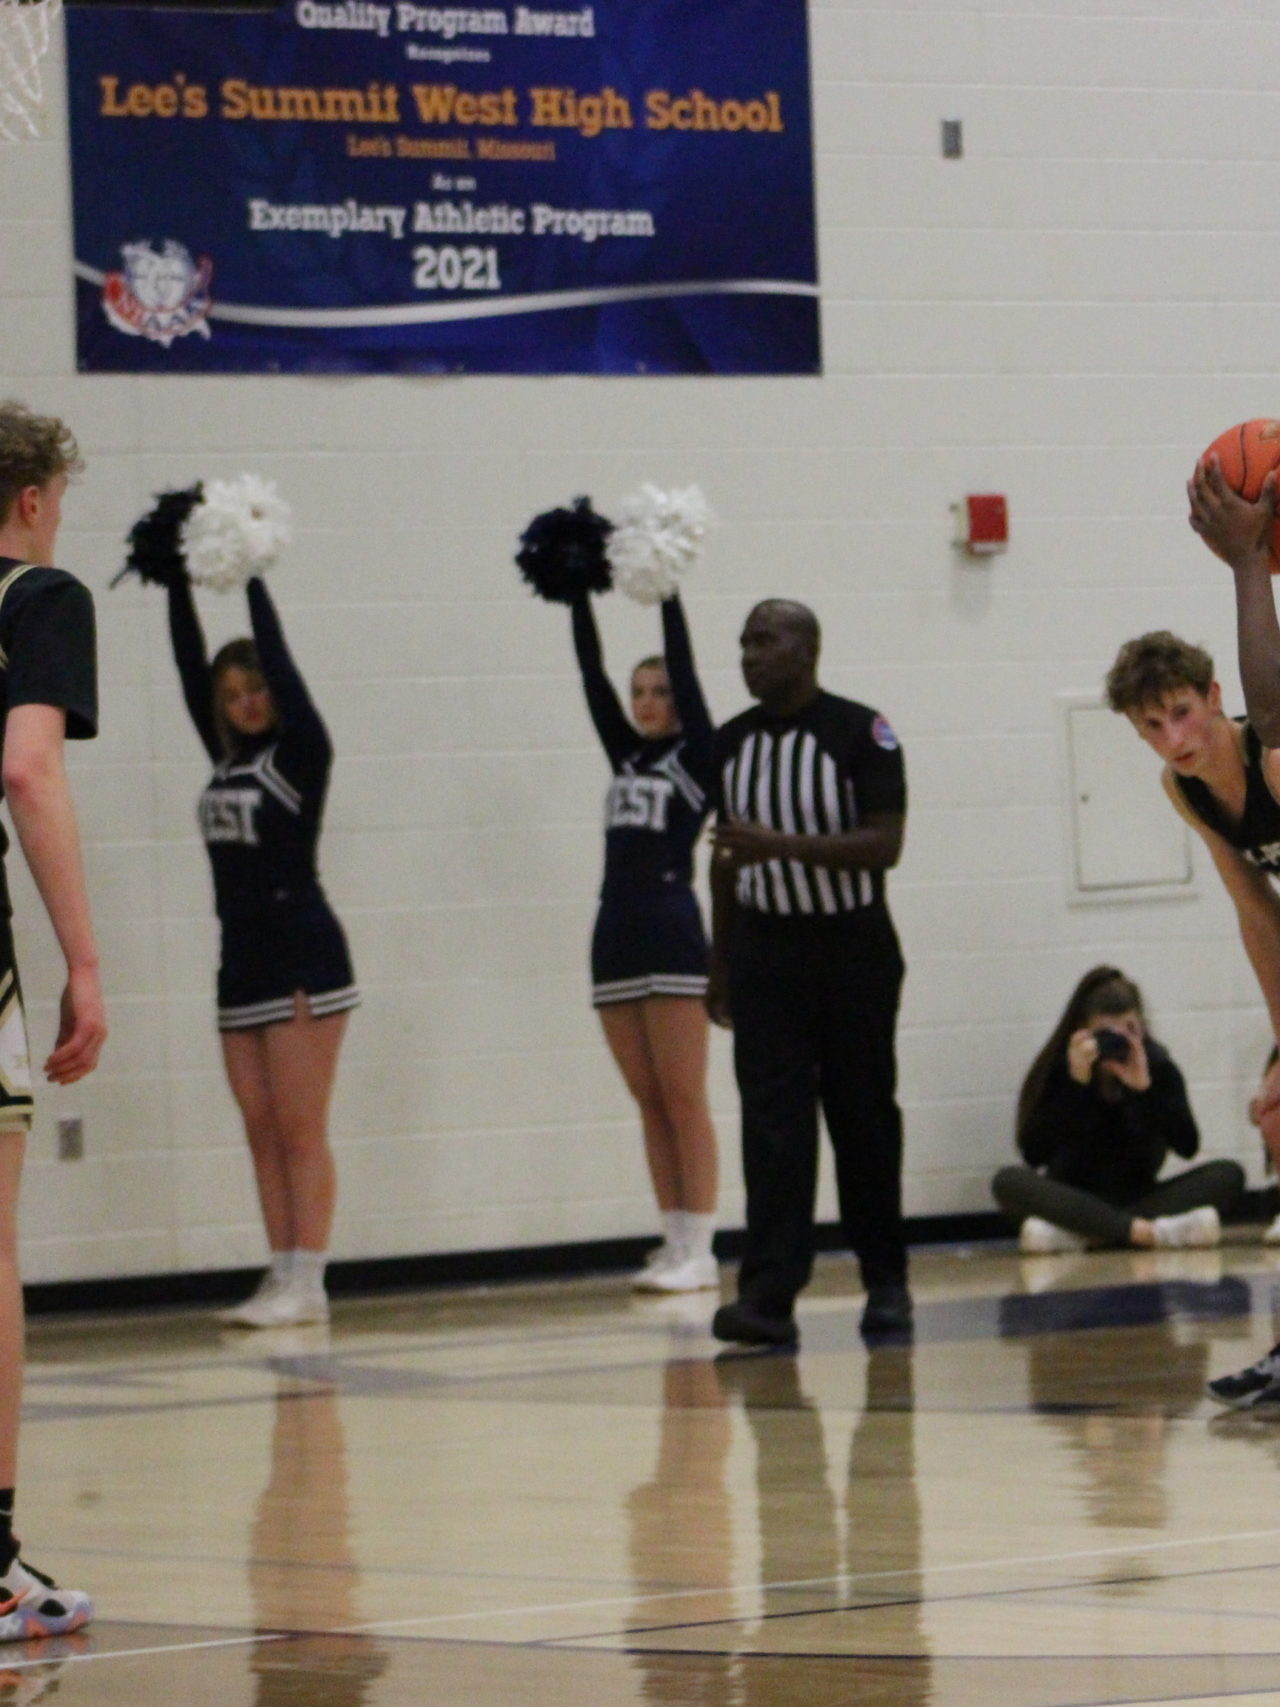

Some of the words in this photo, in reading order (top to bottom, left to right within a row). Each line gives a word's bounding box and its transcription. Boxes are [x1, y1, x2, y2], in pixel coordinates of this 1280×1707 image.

[295, 2, 391, 37] Quality
[396, 4, 508, 39] Program
[513, 5, 595, 38] Award
[100, 73, 208, 119] Lee's
[220, 79, 400, 123] Summit
[411, 82, 518, 126] West
[529, 86, 633, 138] High
[645, 89, 784, 133] School
[248, 199, 406, 239] Exemplary
[411, 201, 526, 235] Athletic
[530, 203, 655, 243] Program
[412, 245, 502, 290] 2021
[202, 788, 261, 845] EST
[608, 776, 673, 831] EST
